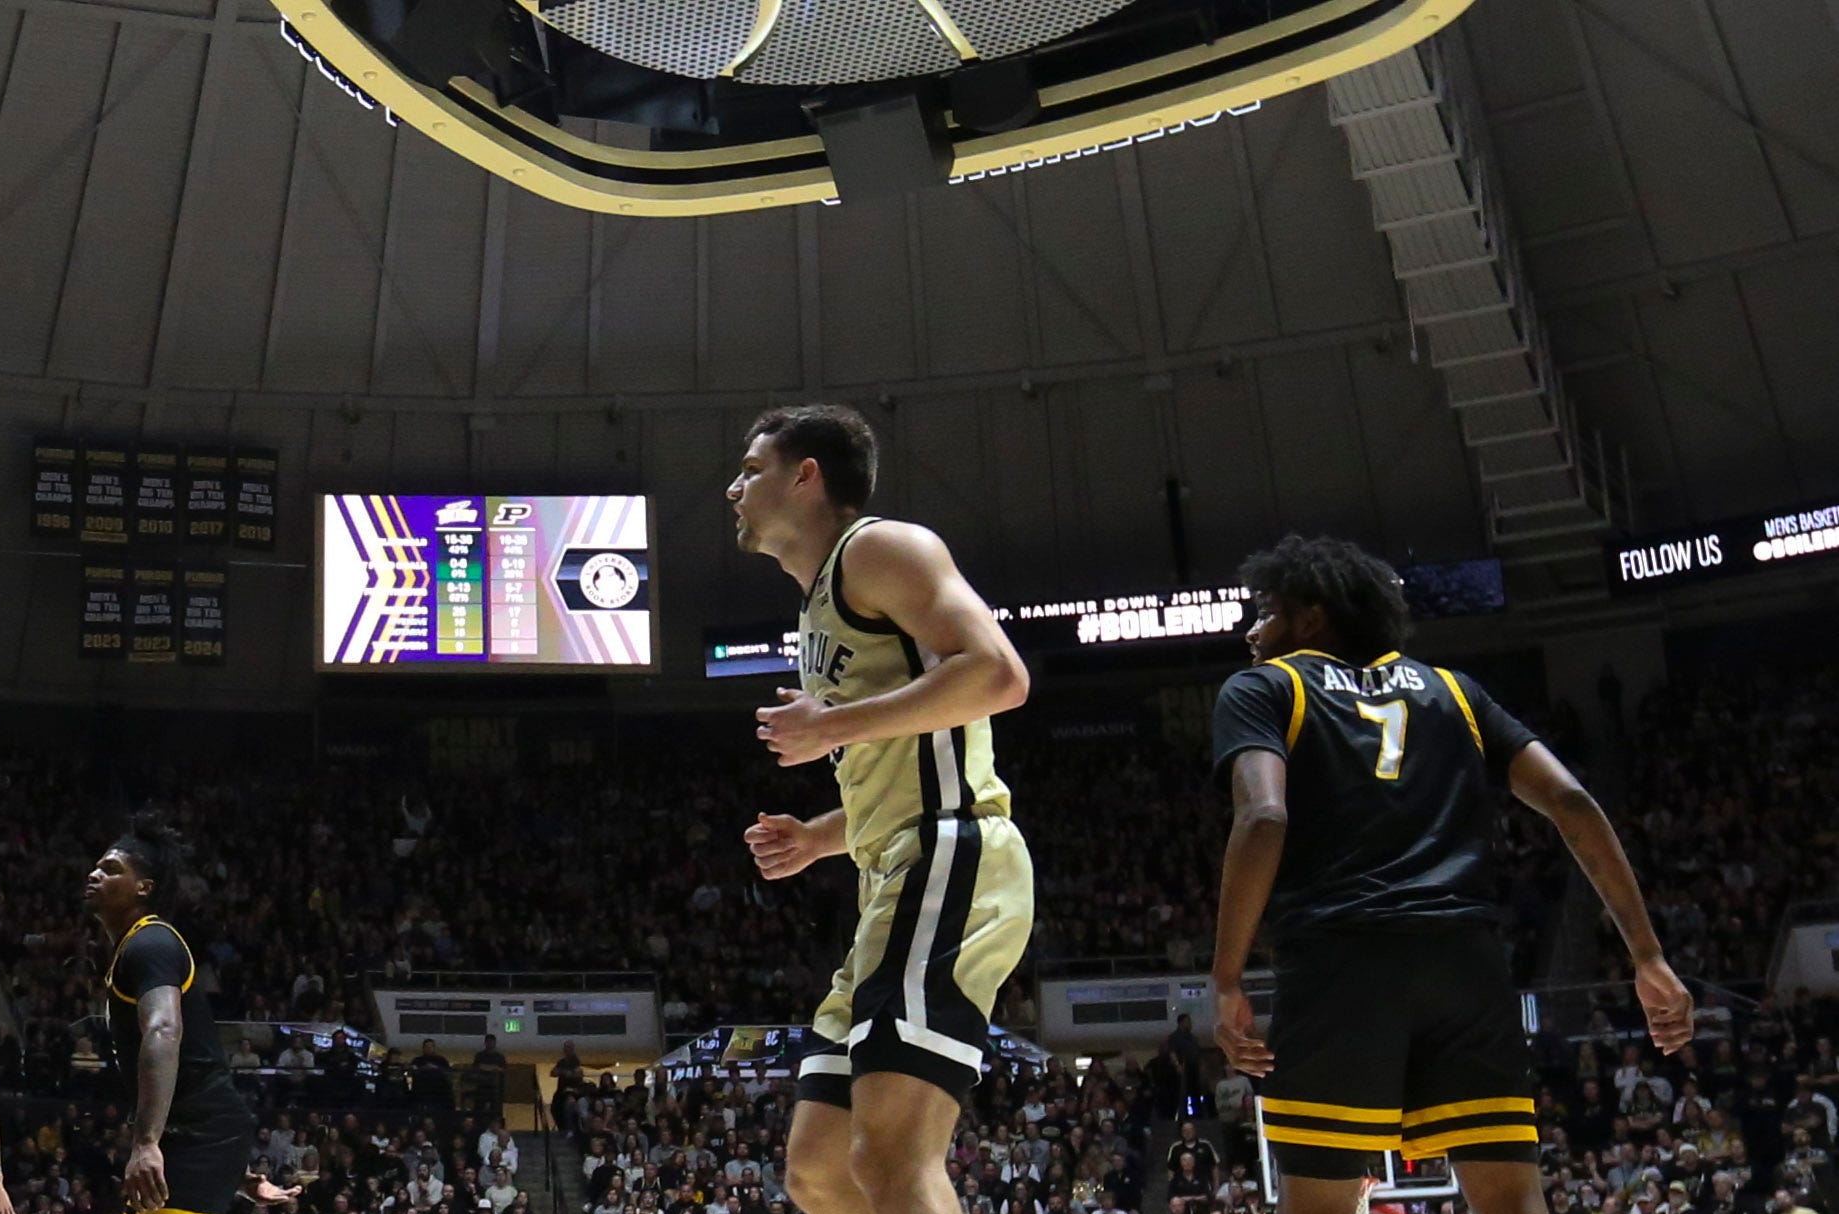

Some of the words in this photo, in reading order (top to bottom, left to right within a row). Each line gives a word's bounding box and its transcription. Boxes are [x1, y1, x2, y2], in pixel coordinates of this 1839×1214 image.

[1764, 514, 1799, 538] MEN'S
[1798, 504, 1839, 532] BASKET
[1620, 540, 1691, 582] FOLLOW
[1696, 534, 1723, 567] US
[1020, 600, 1097, 619] HAMMER
[1104, 595, 1164, 612] DOWN.
[1171, 590, 1211, 605] JOIN
[1217, 587, 1251, 601] THE
[1077, 601, 1243, 644] #BOILERUP
[1324, 664, 1426, 697] ADAMS
[1356, 699, 1408, 780] 7
